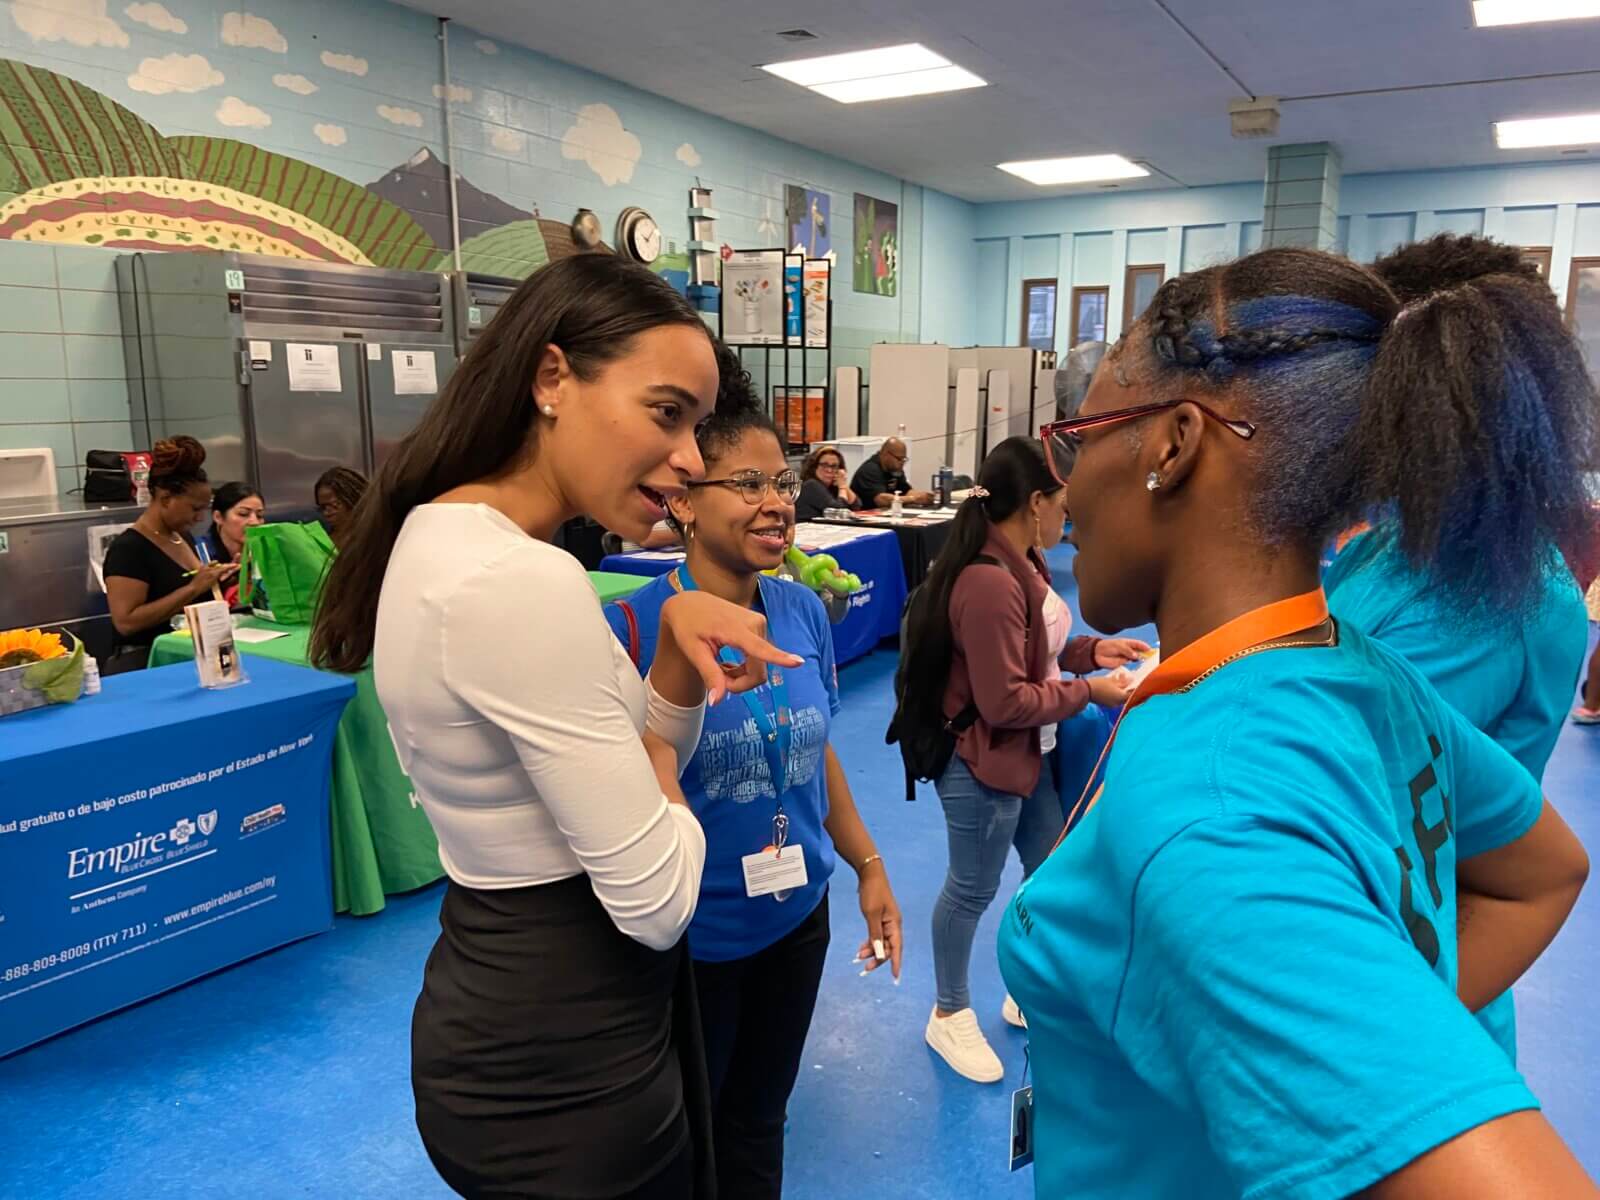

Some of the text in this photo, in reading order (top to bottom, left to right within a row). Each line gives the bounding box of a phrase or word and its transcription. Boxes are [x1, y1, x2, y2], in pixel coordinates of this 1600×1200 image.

[19, 811, 65, 832] gratuito
[67, 808, 75, 818] o
[78, 804, 91, 815] de
[93, 798, 116, 812] bajo
[118, 789, 147, 805] costo
[149, 772, 206, 799] patrocinado
[208, 766, 224, 781] por
[226, 761, 235, 774] el
[236, 753, 266, 770] Estado
[267, 748, 278, 760] de
[67, 831, 166, 879] Empire
[0, 942, 91, 983] -888-809-8009
[93, 932, 118, 951] (TTY
[121, 922, 147, 941] 711)
[164, 875, 277, 926] www.empireblue.com/ny
[83, 894, 117, 911] Anthem
